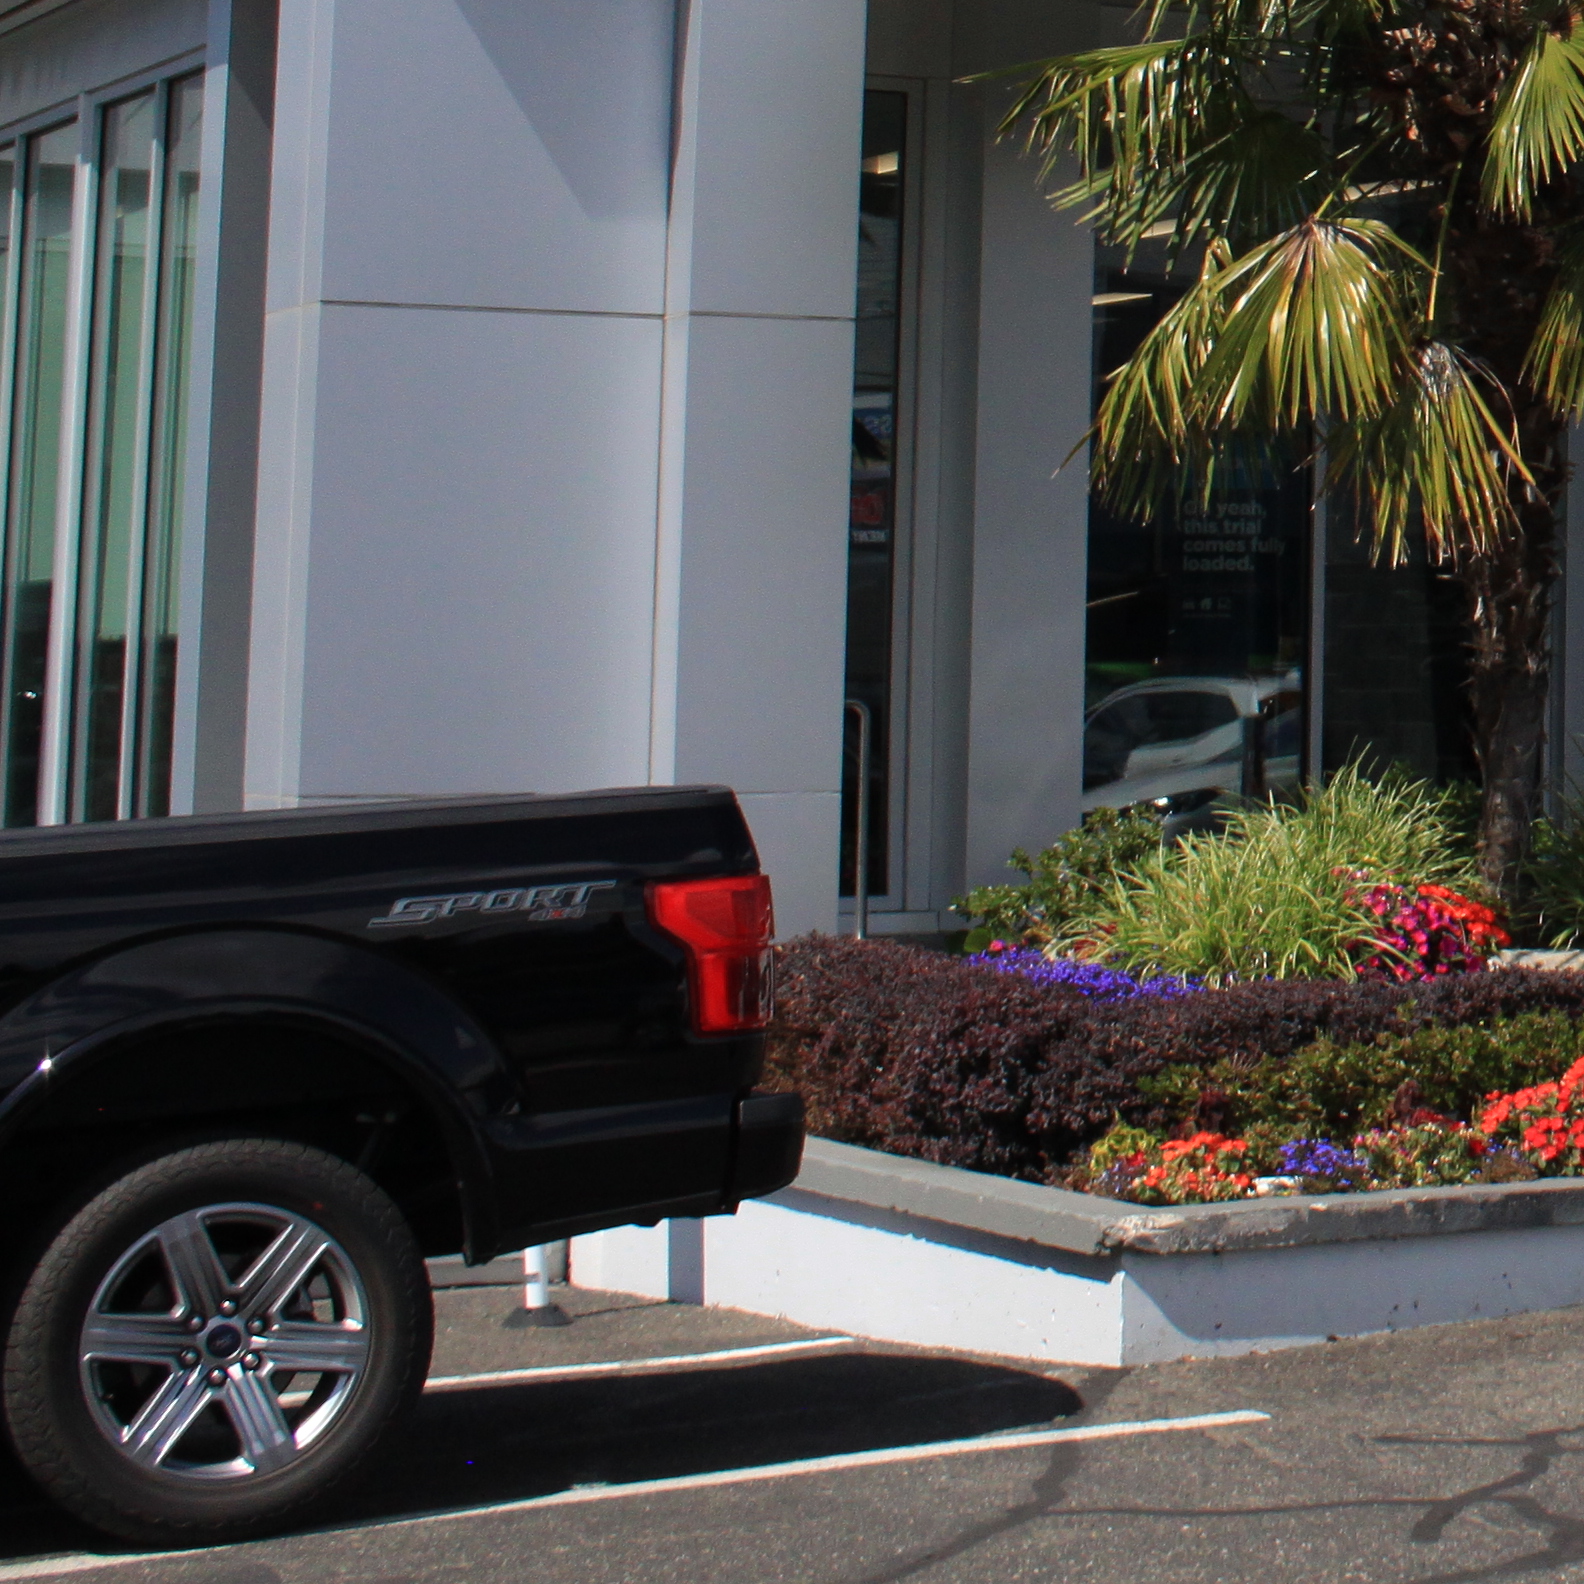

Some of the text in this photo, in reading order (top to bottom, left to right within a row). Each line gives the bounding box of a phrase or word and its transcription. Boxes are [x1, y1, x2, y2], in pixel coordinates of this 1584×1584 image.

[1217, 499, 1267, 519] yeah,
[1184, 518, 1262, 534] this trial
[1183, 536, 1287, 556] comes fully
[1183, 555, 1255, 571] loaded.
[367, 879, 618, 928] SPORT
